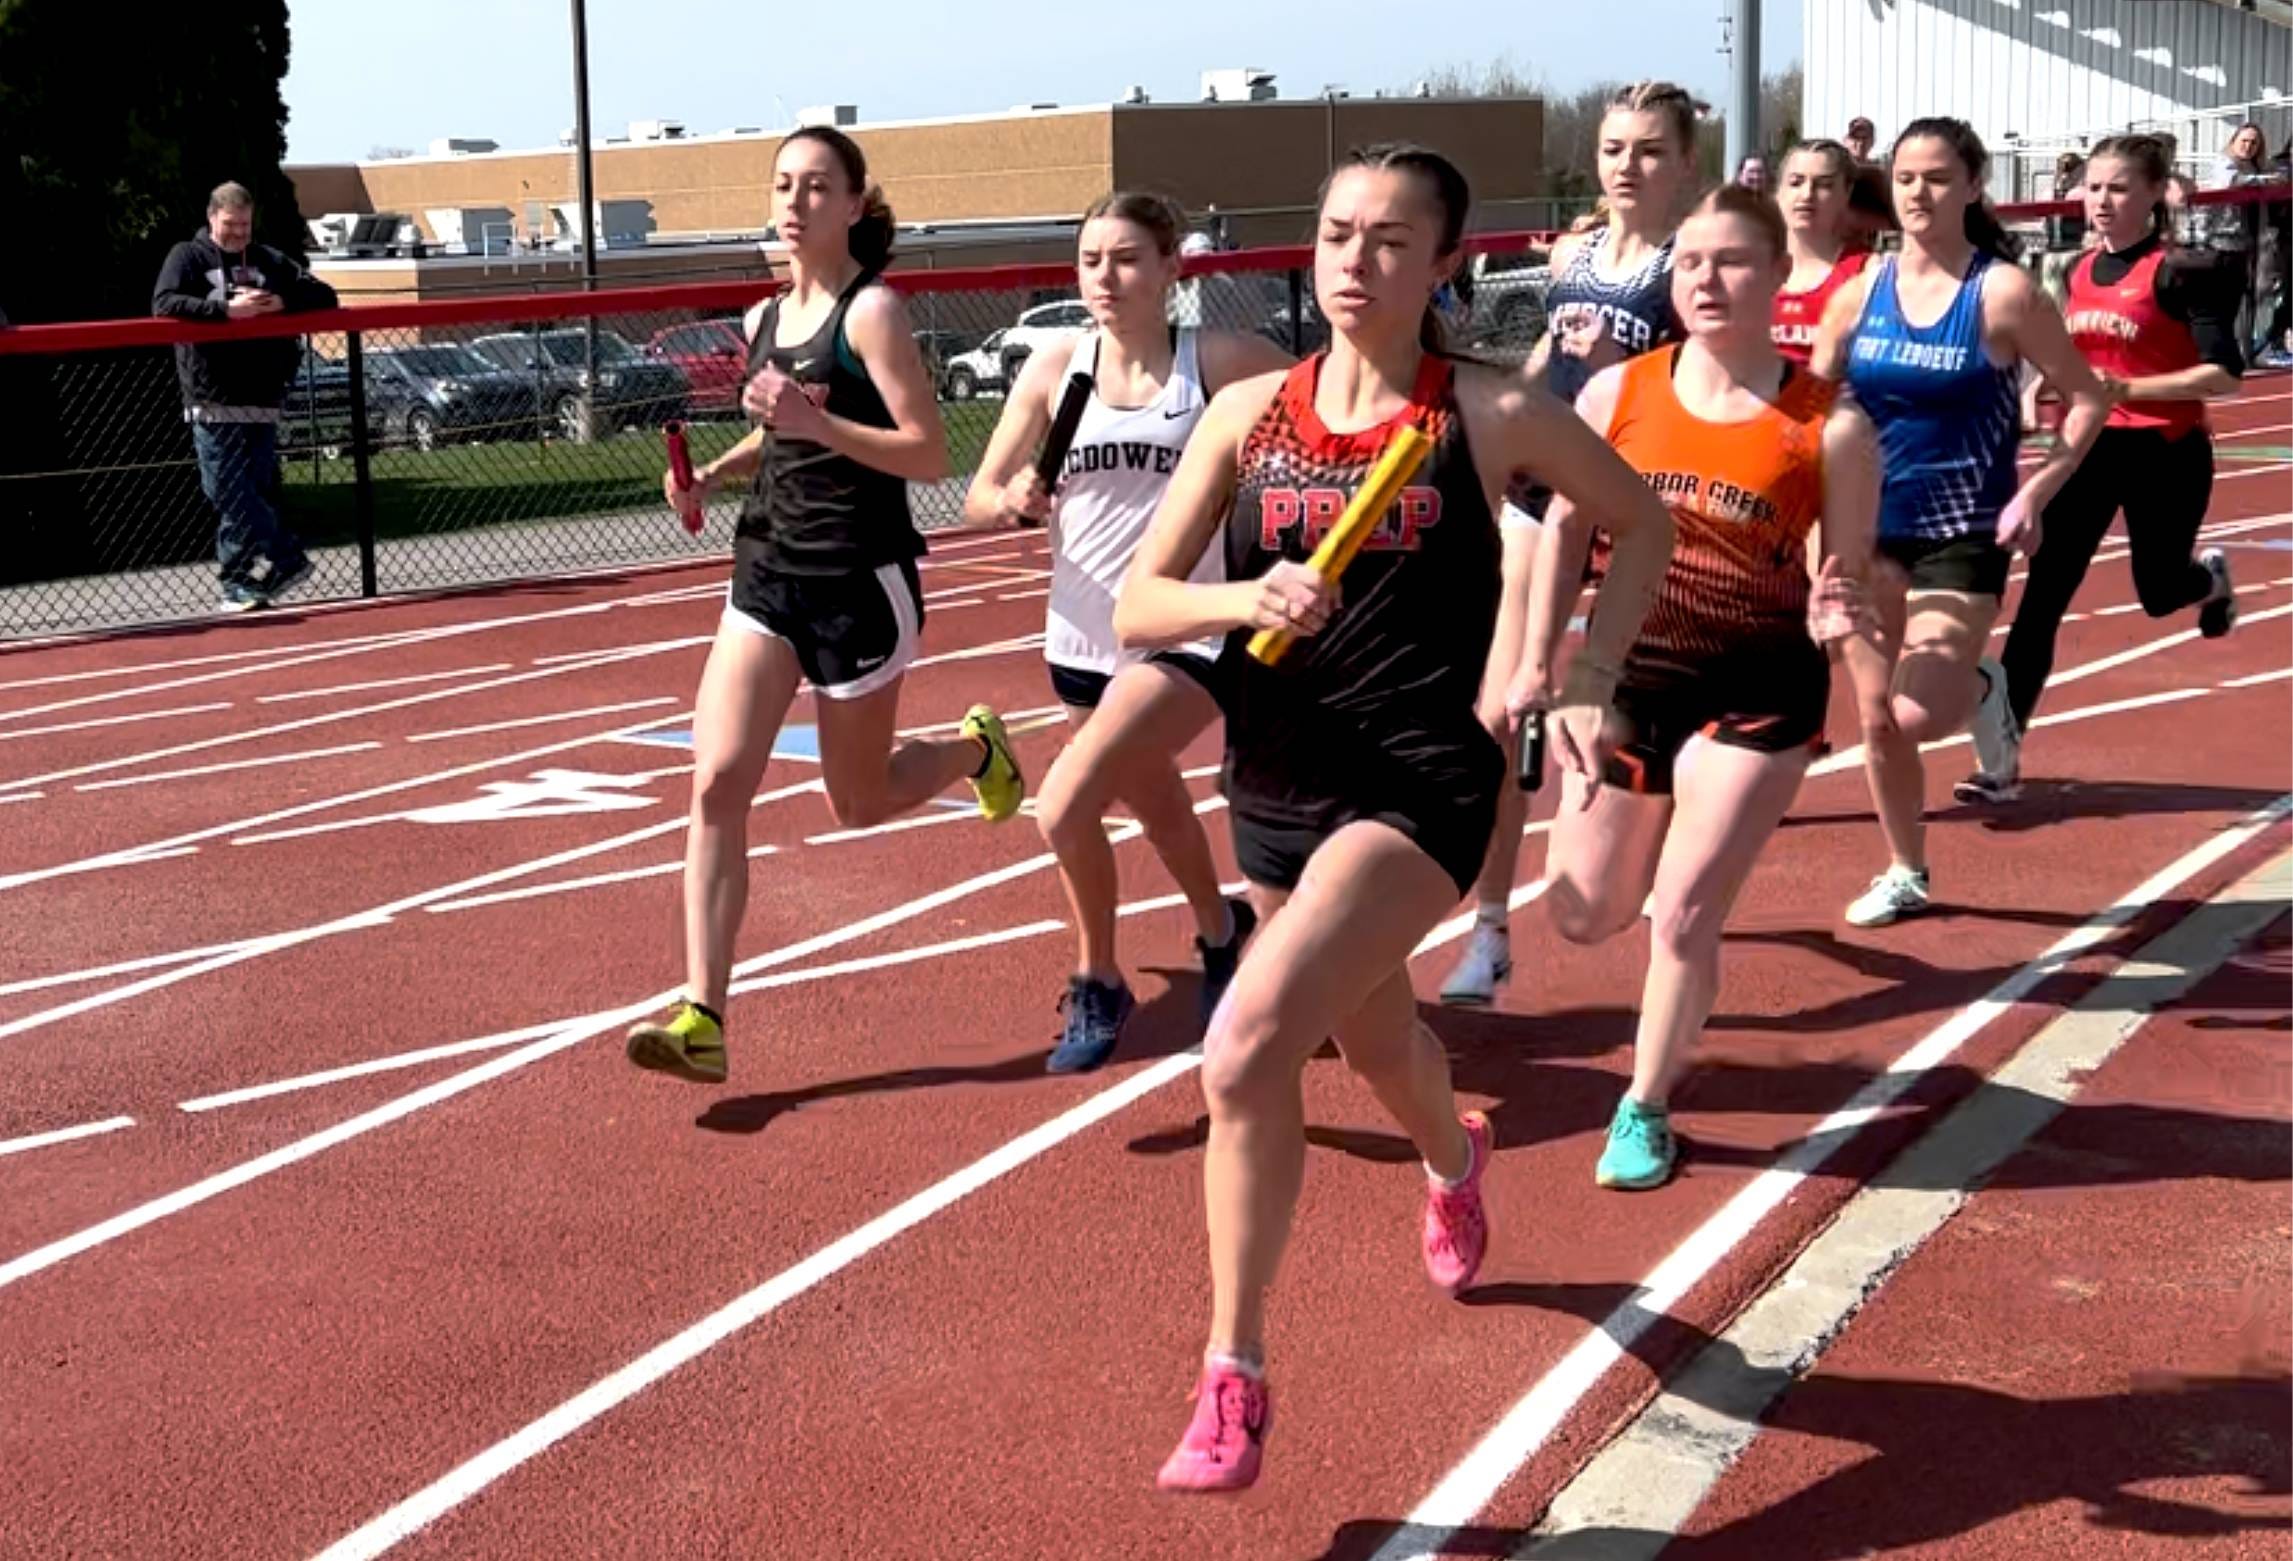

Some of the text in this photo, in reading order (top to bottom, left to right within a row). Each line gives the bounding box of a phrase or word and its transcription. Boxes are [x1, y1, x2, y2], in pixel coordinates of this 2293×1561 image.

[1547, 302, 1650, 351] MCER
[1062, 441, 1182, 480] CDOWE
[1640, 472, 1699, 494] RBOR
[1260, 486, 1443, 552] PRP
